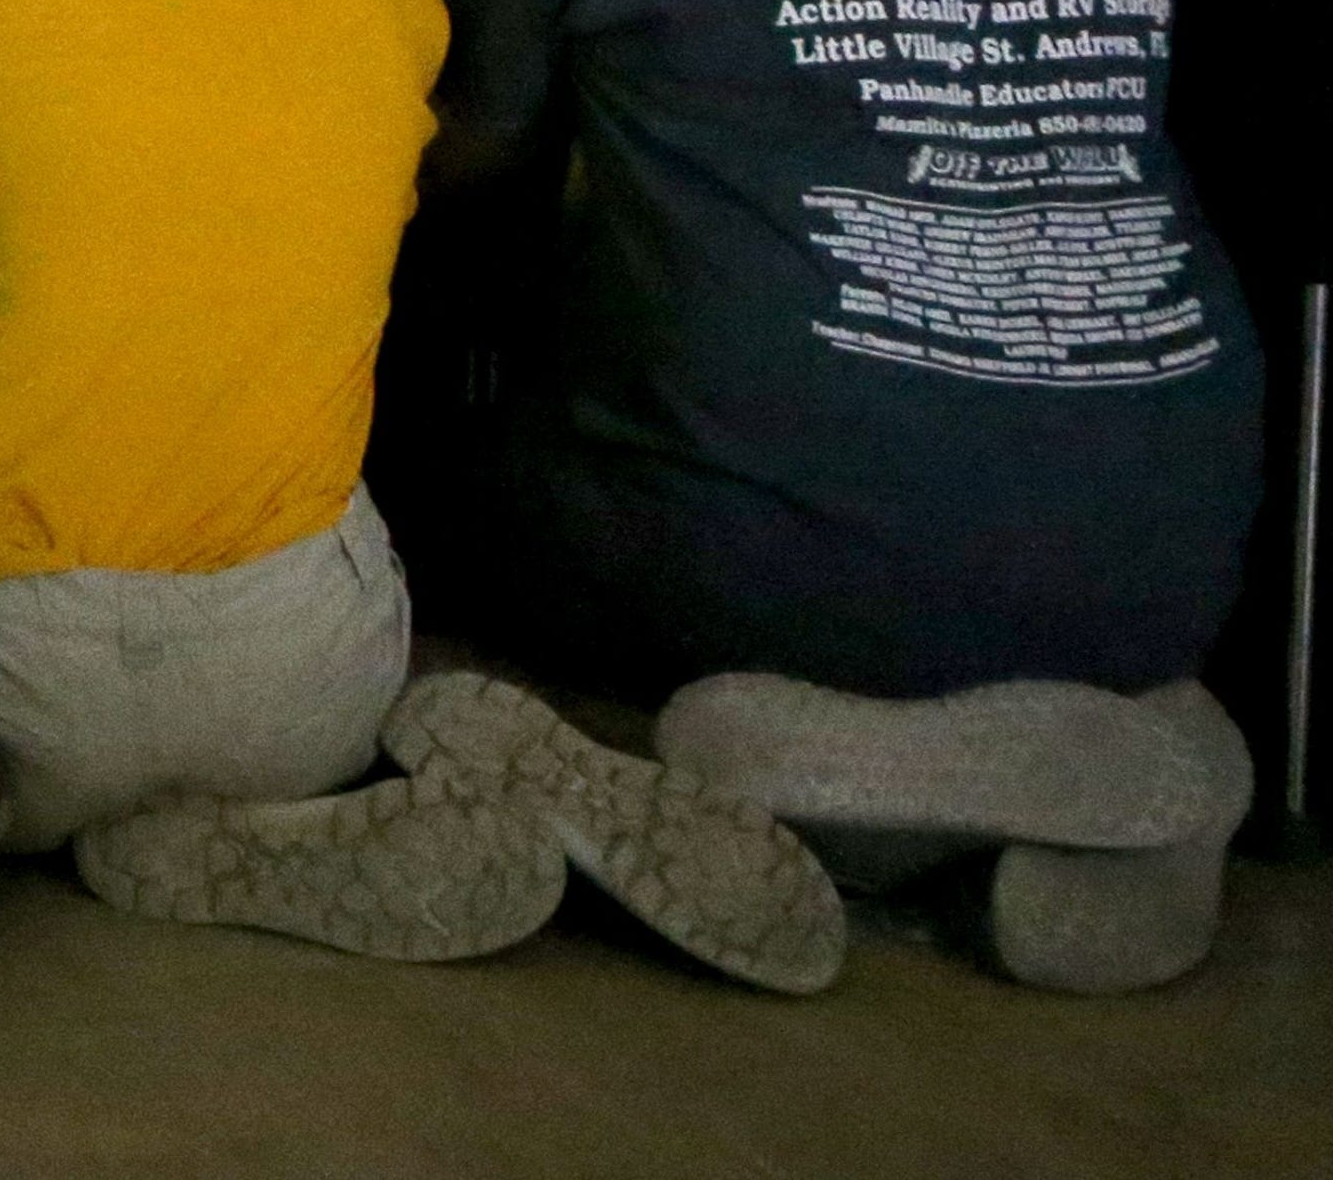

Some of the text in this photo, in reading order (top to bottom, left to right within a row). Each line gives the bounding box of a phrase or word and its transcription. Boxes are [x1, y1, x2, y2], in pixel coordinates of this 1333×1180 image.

[791, 33, 887, 65] Little
[893, 32, 975, 72] Village
[981, 36, 1026, 65] St.
[1035, 29, 1147, 60] Andrews,
[858, 77, 974, 108] Panhandle
[1106, 76, 1146, 100] FCU
